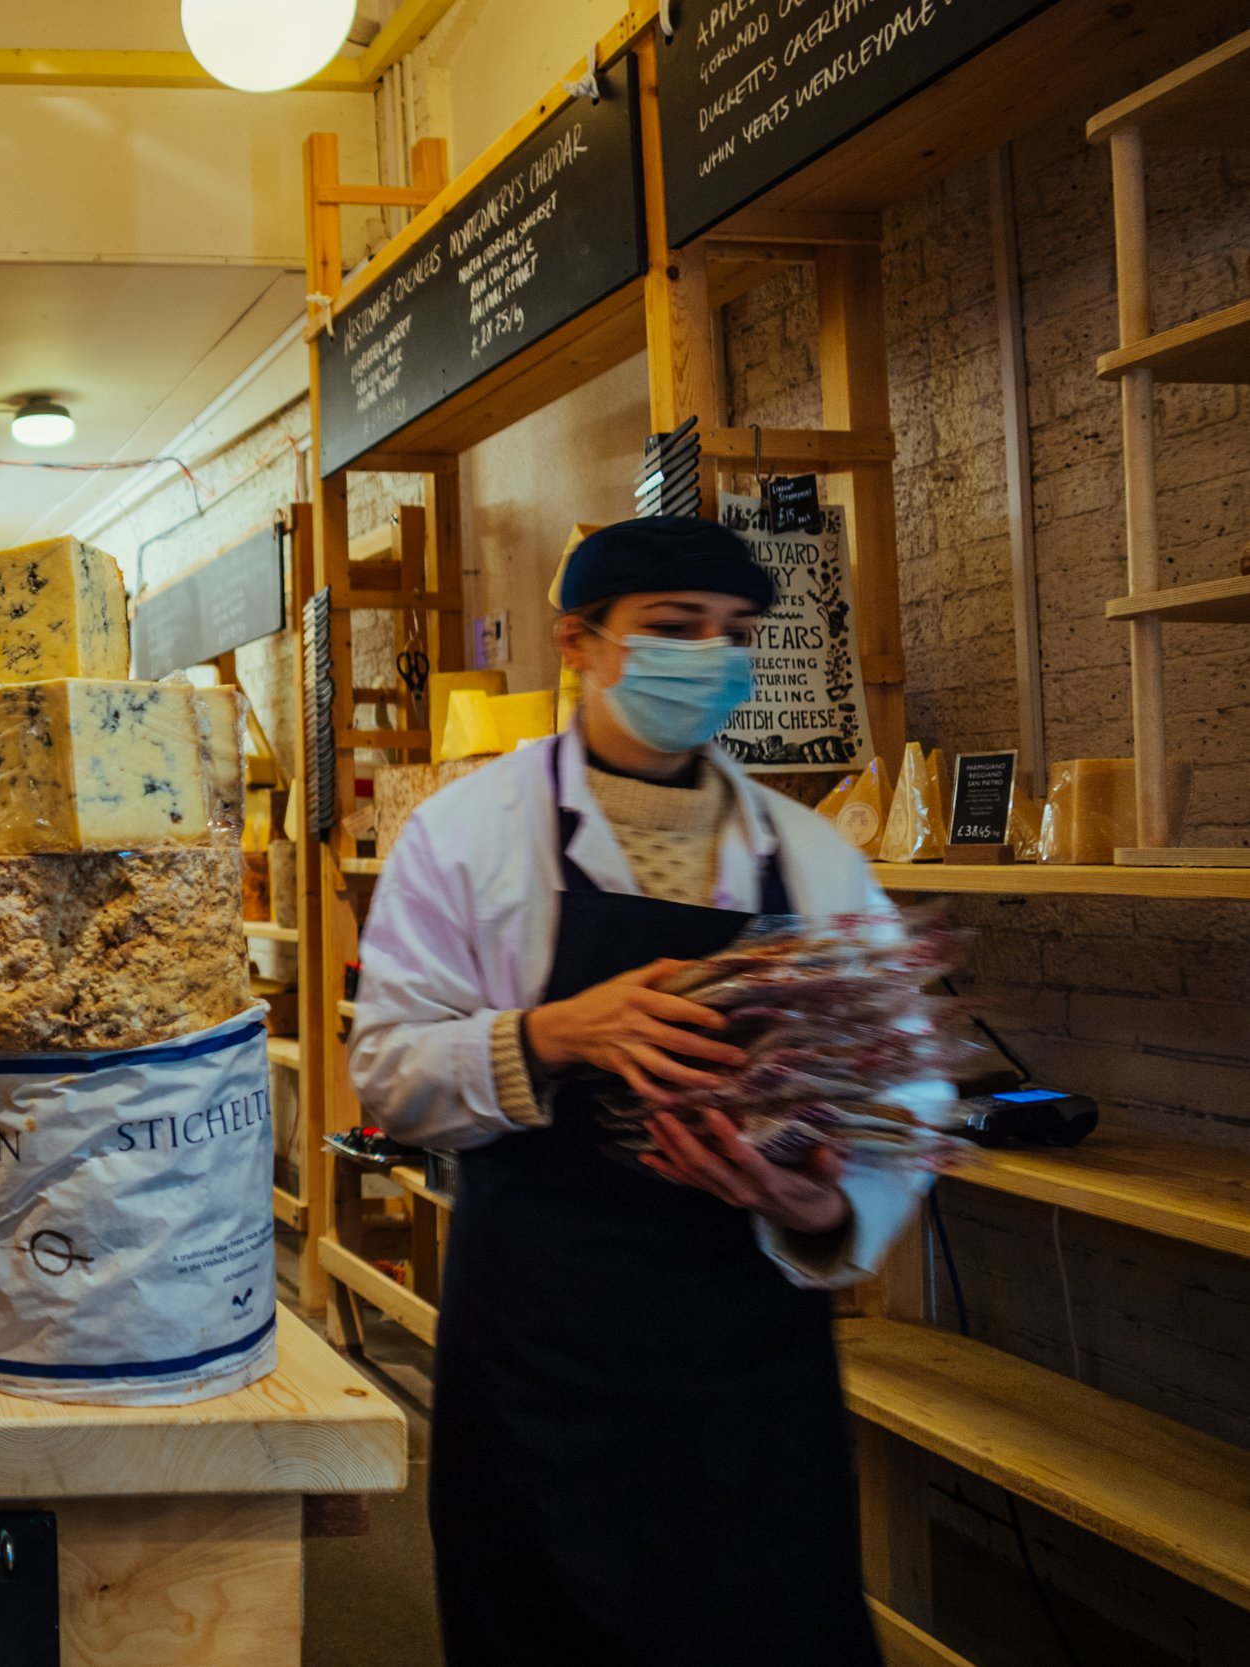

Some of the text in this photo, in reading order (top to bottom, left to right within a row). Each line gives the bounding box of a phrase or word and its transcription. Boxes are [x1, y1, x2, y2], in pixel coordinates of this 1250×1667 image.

[699, 0, 936, 178] WHIN YEATS WENSLEYDALE
[529, 122, 589, 194] CHEDDAR
[775, 542, 819, 565] YARD
[751, 625, 824, 650] YEARS
[751, 673, 808, 686] ATURING
[748, 690, 815, 703] ELLING
[724, 708, 838, 730] BRITISH CHEESE
